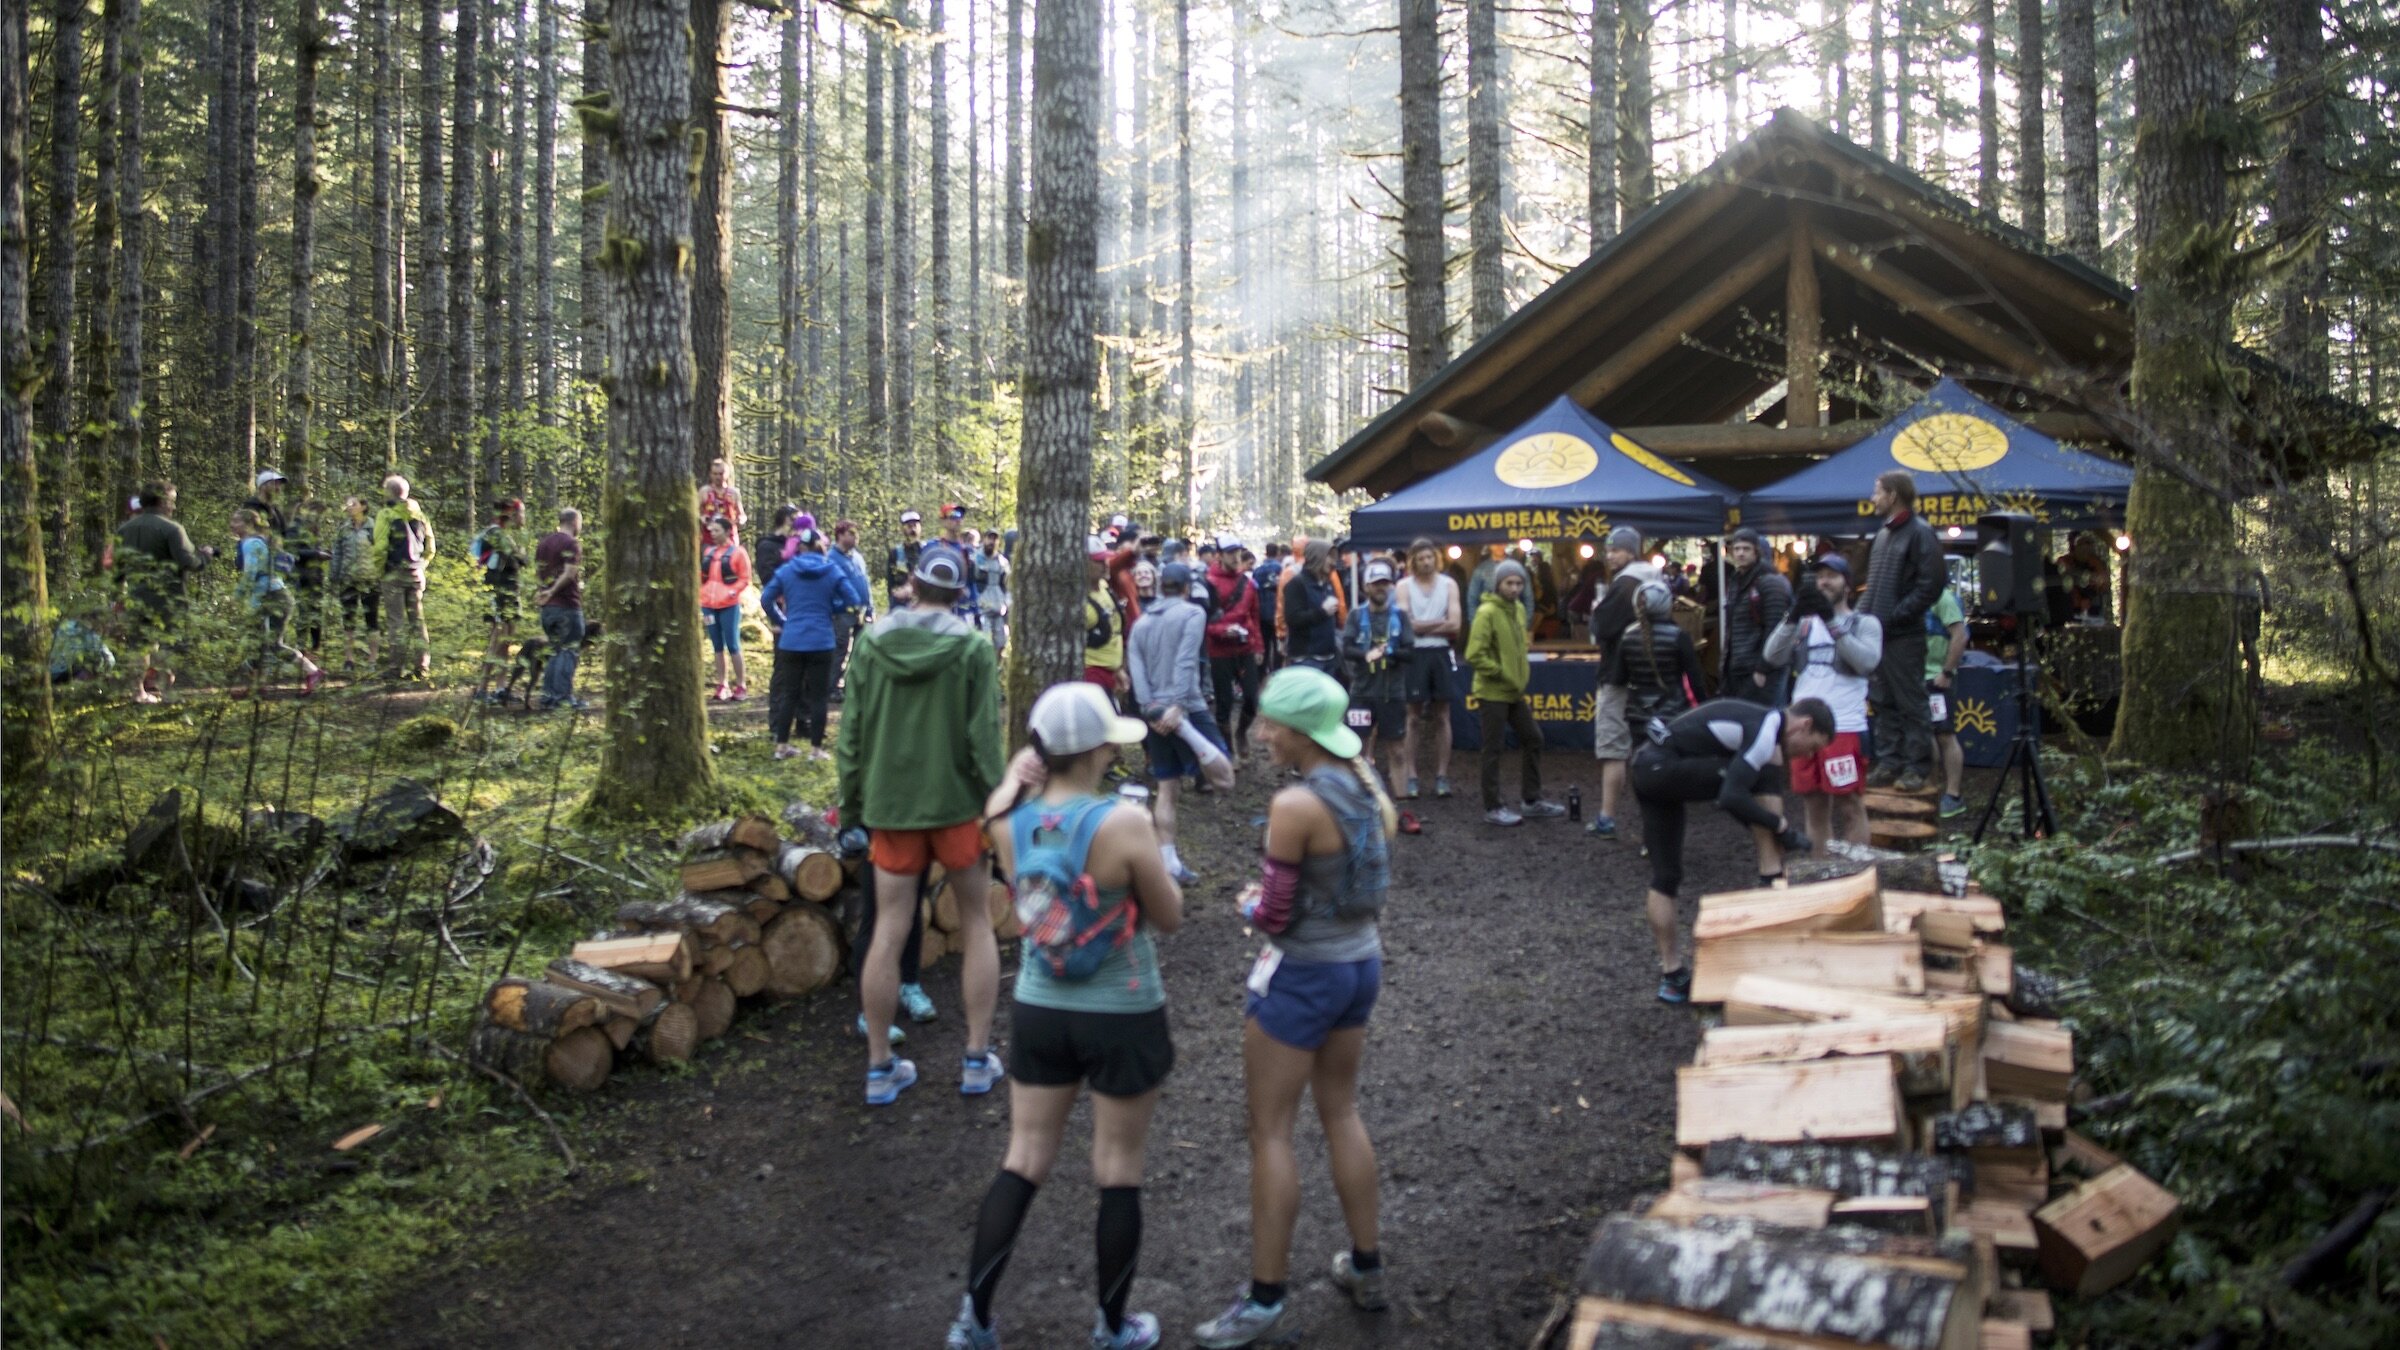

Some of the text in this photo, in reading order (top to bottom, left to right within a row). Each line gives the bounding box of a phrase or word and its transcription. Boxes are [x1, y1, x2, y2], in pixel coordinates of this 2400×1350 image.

[1857, 495, 1988, 516] DBREAK
[1449, 510, 1561, 530] DAYBREAK
[1928, 514, 1979, 526] RACIN
[1508, 527, 1561, 539] RACING
[1532, 711, 1573, 721] ACING
[1829, 759, 1853, 777] 487
